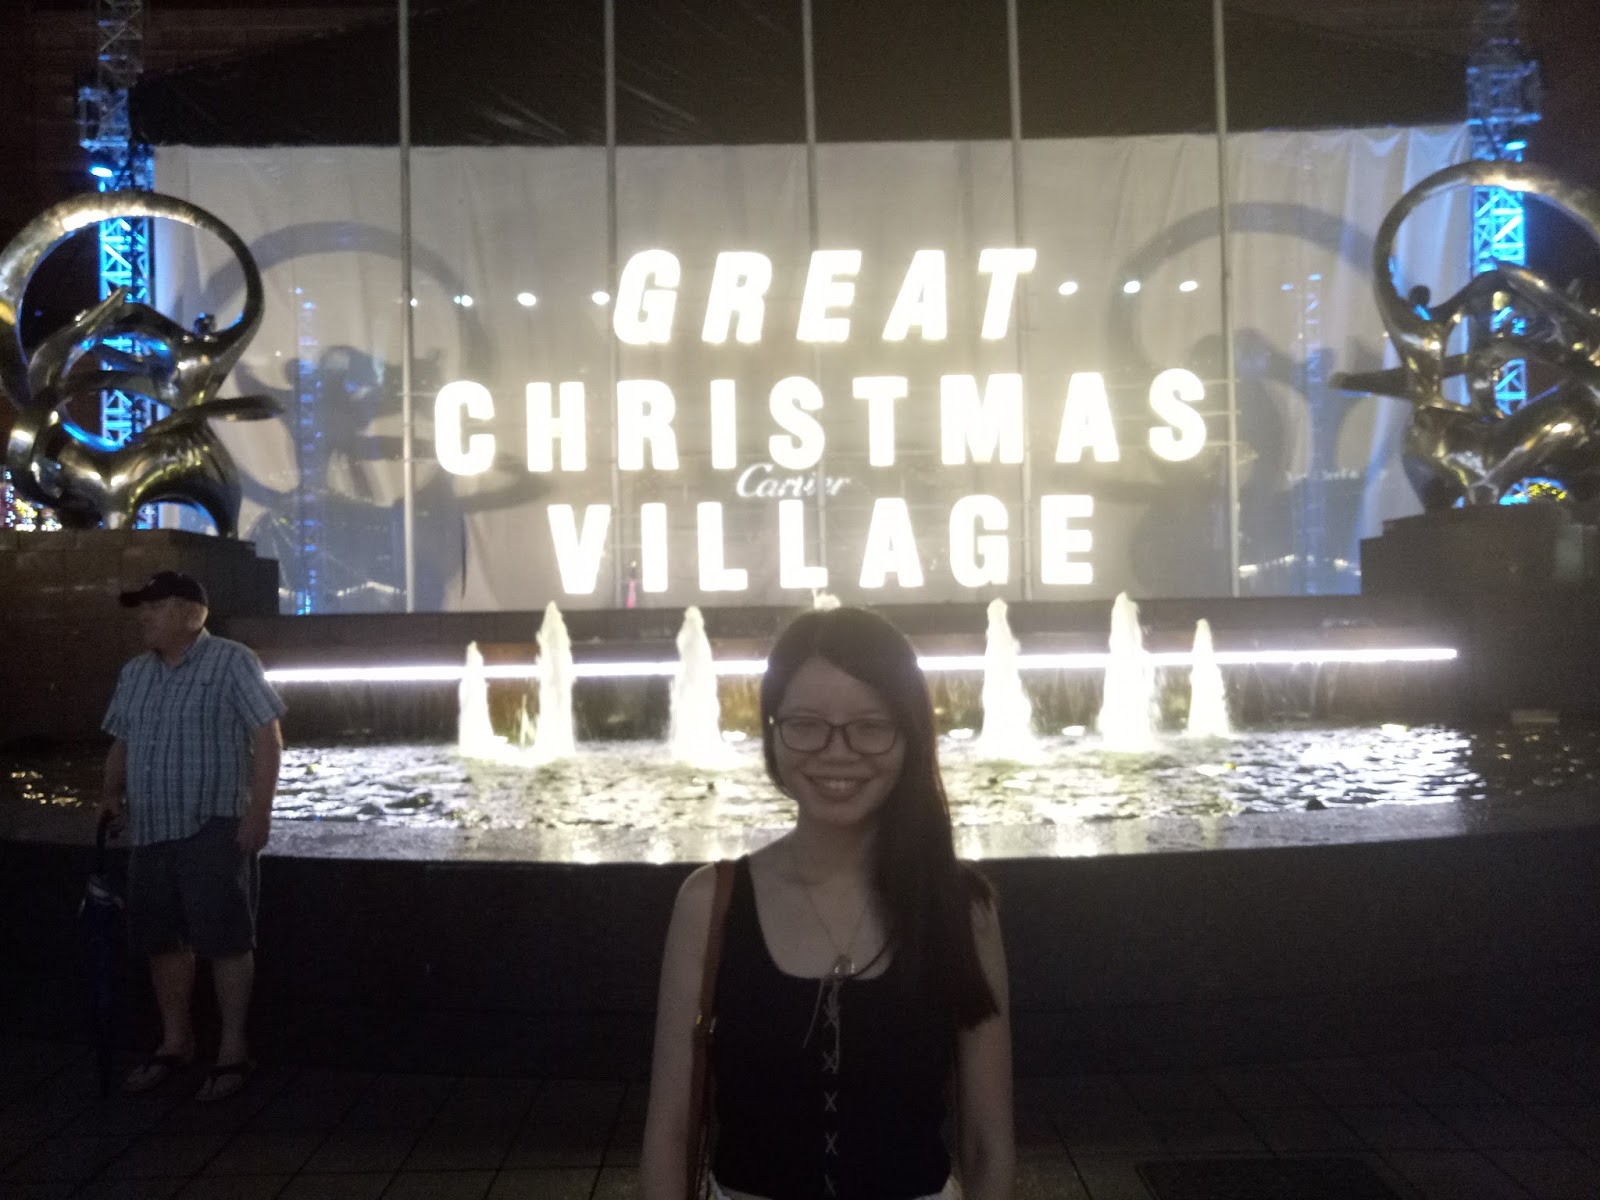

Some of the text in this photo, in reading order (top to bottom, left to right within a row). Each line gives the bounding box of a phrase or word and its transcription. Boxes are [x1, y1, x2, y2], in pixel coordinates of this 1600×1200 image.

[613, 248, 1037, 345] GREAT
[434, 368, 1208, 477] CHRISTMAS
[547, 494, 1095, 595] VILLAGE
